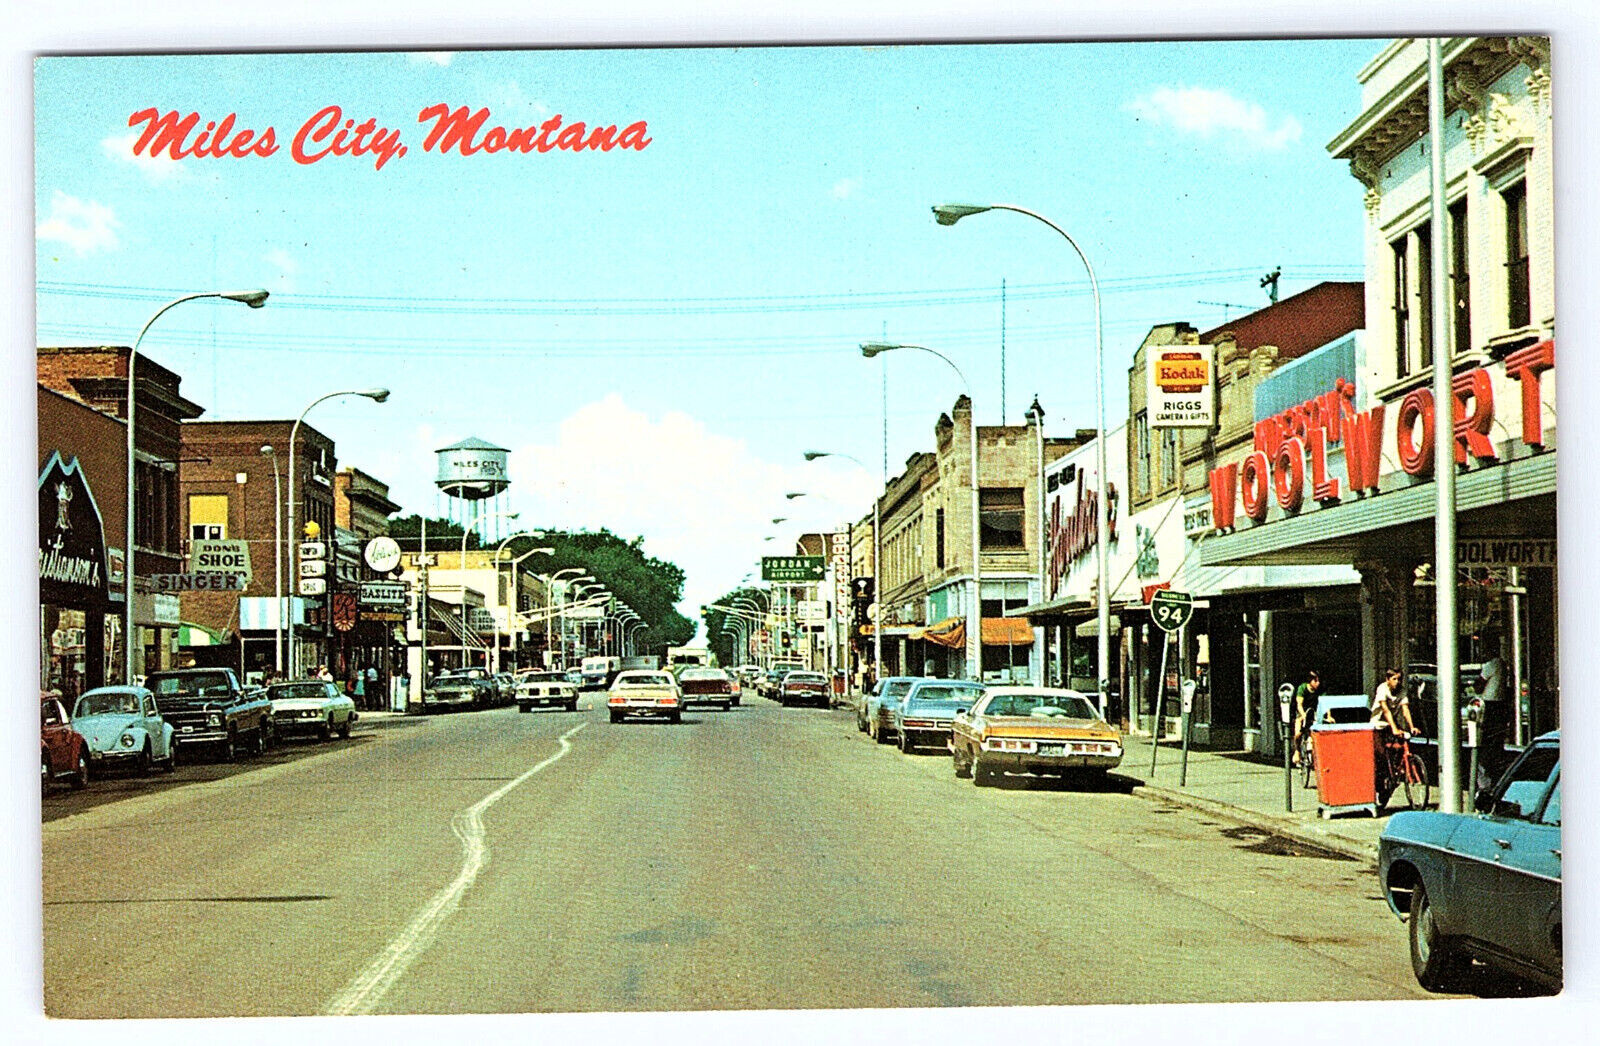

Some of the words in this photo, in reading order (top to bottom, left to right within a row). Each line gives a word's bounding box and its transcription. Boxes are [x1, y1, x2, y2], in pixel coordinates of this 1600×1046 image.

[1160, 367, 1205, 379] Kodak
[1163, 401, 1202, 410] RIGGS
[1156, 413, 1183, 421] CAMERA
[1190, 412, 1209, 420] GIFTS
[453, 460, 479, 468] MILES
[198, 553, 245, 567] SHOE
[764, 559, 810, 569] JORDAN
[157, 575, 238, 590] SINGER
[1158, 606, 1183, 623] 94
